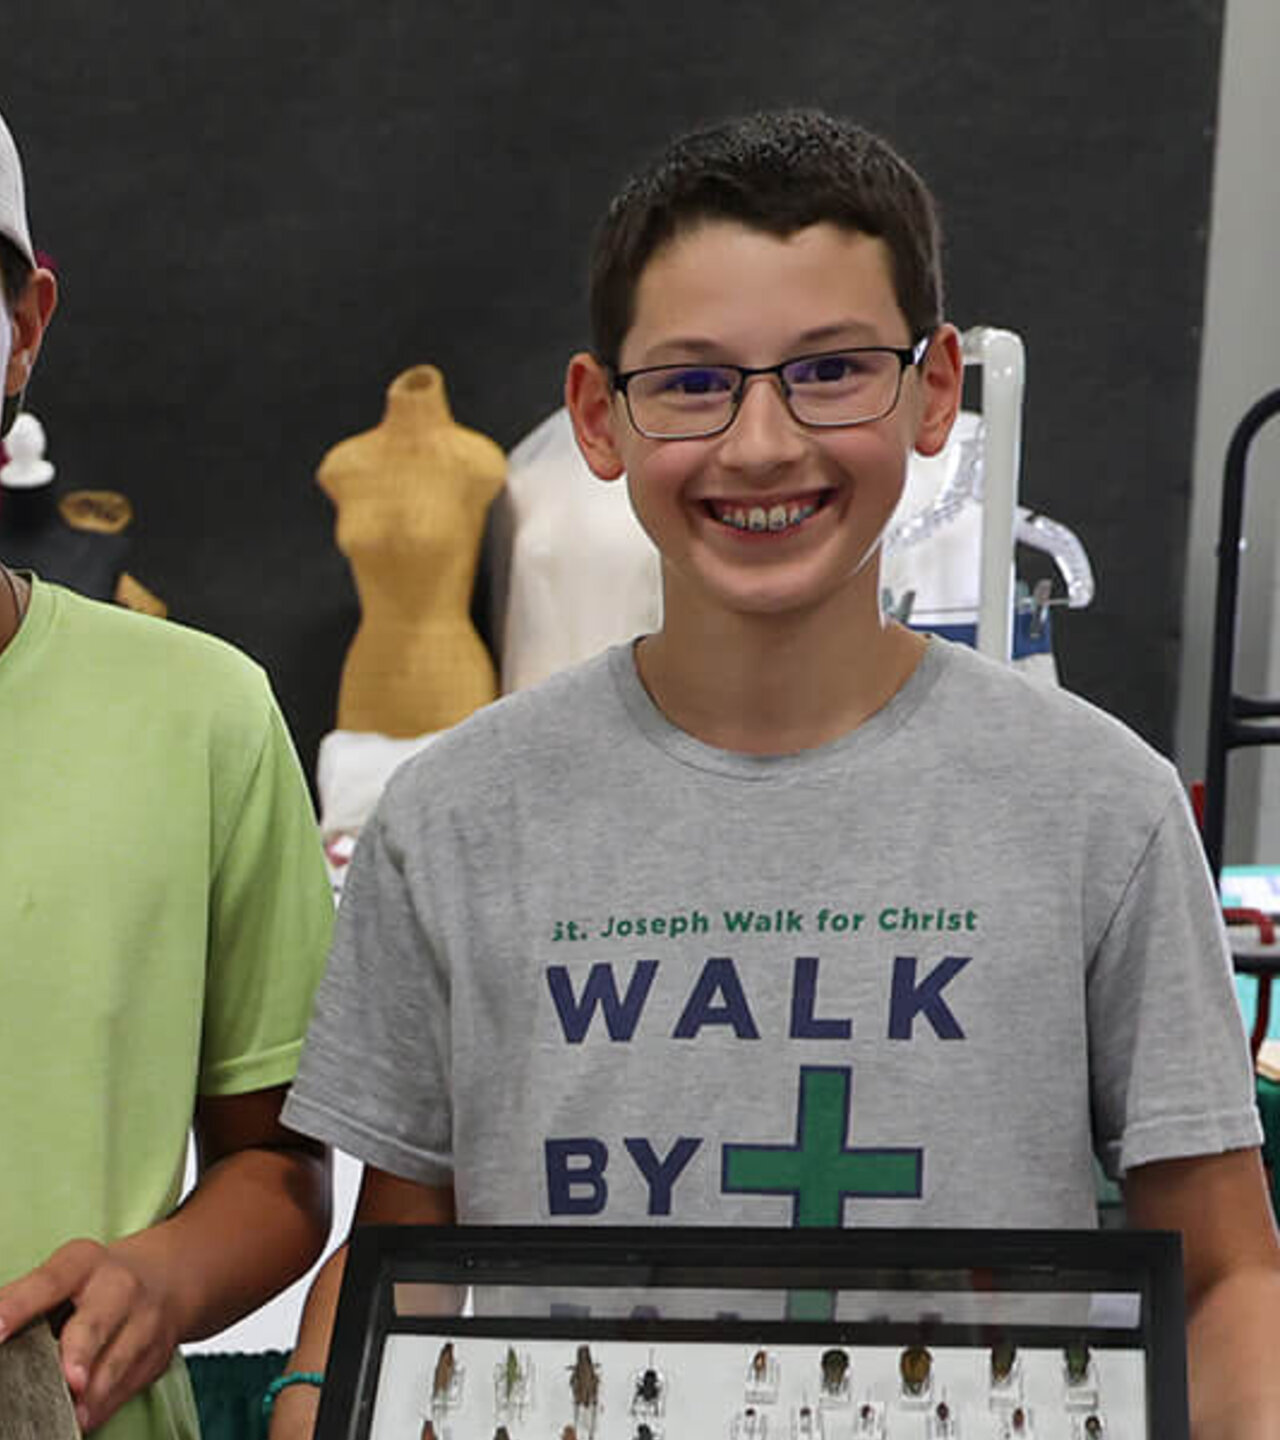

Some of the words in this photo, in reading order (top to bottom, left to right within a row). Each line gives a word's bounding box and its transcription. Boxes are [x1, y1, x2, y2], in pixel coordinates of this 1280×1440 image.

[600, 909, 710, 940] Joseph
[724, 909, 803, 933] Walk
[817, 907, 864, 933] for
[878, 906, 979, 933] Christ
[545, 956, 974, 1044] WALK
[544, 1136, 704, 1217] BY
